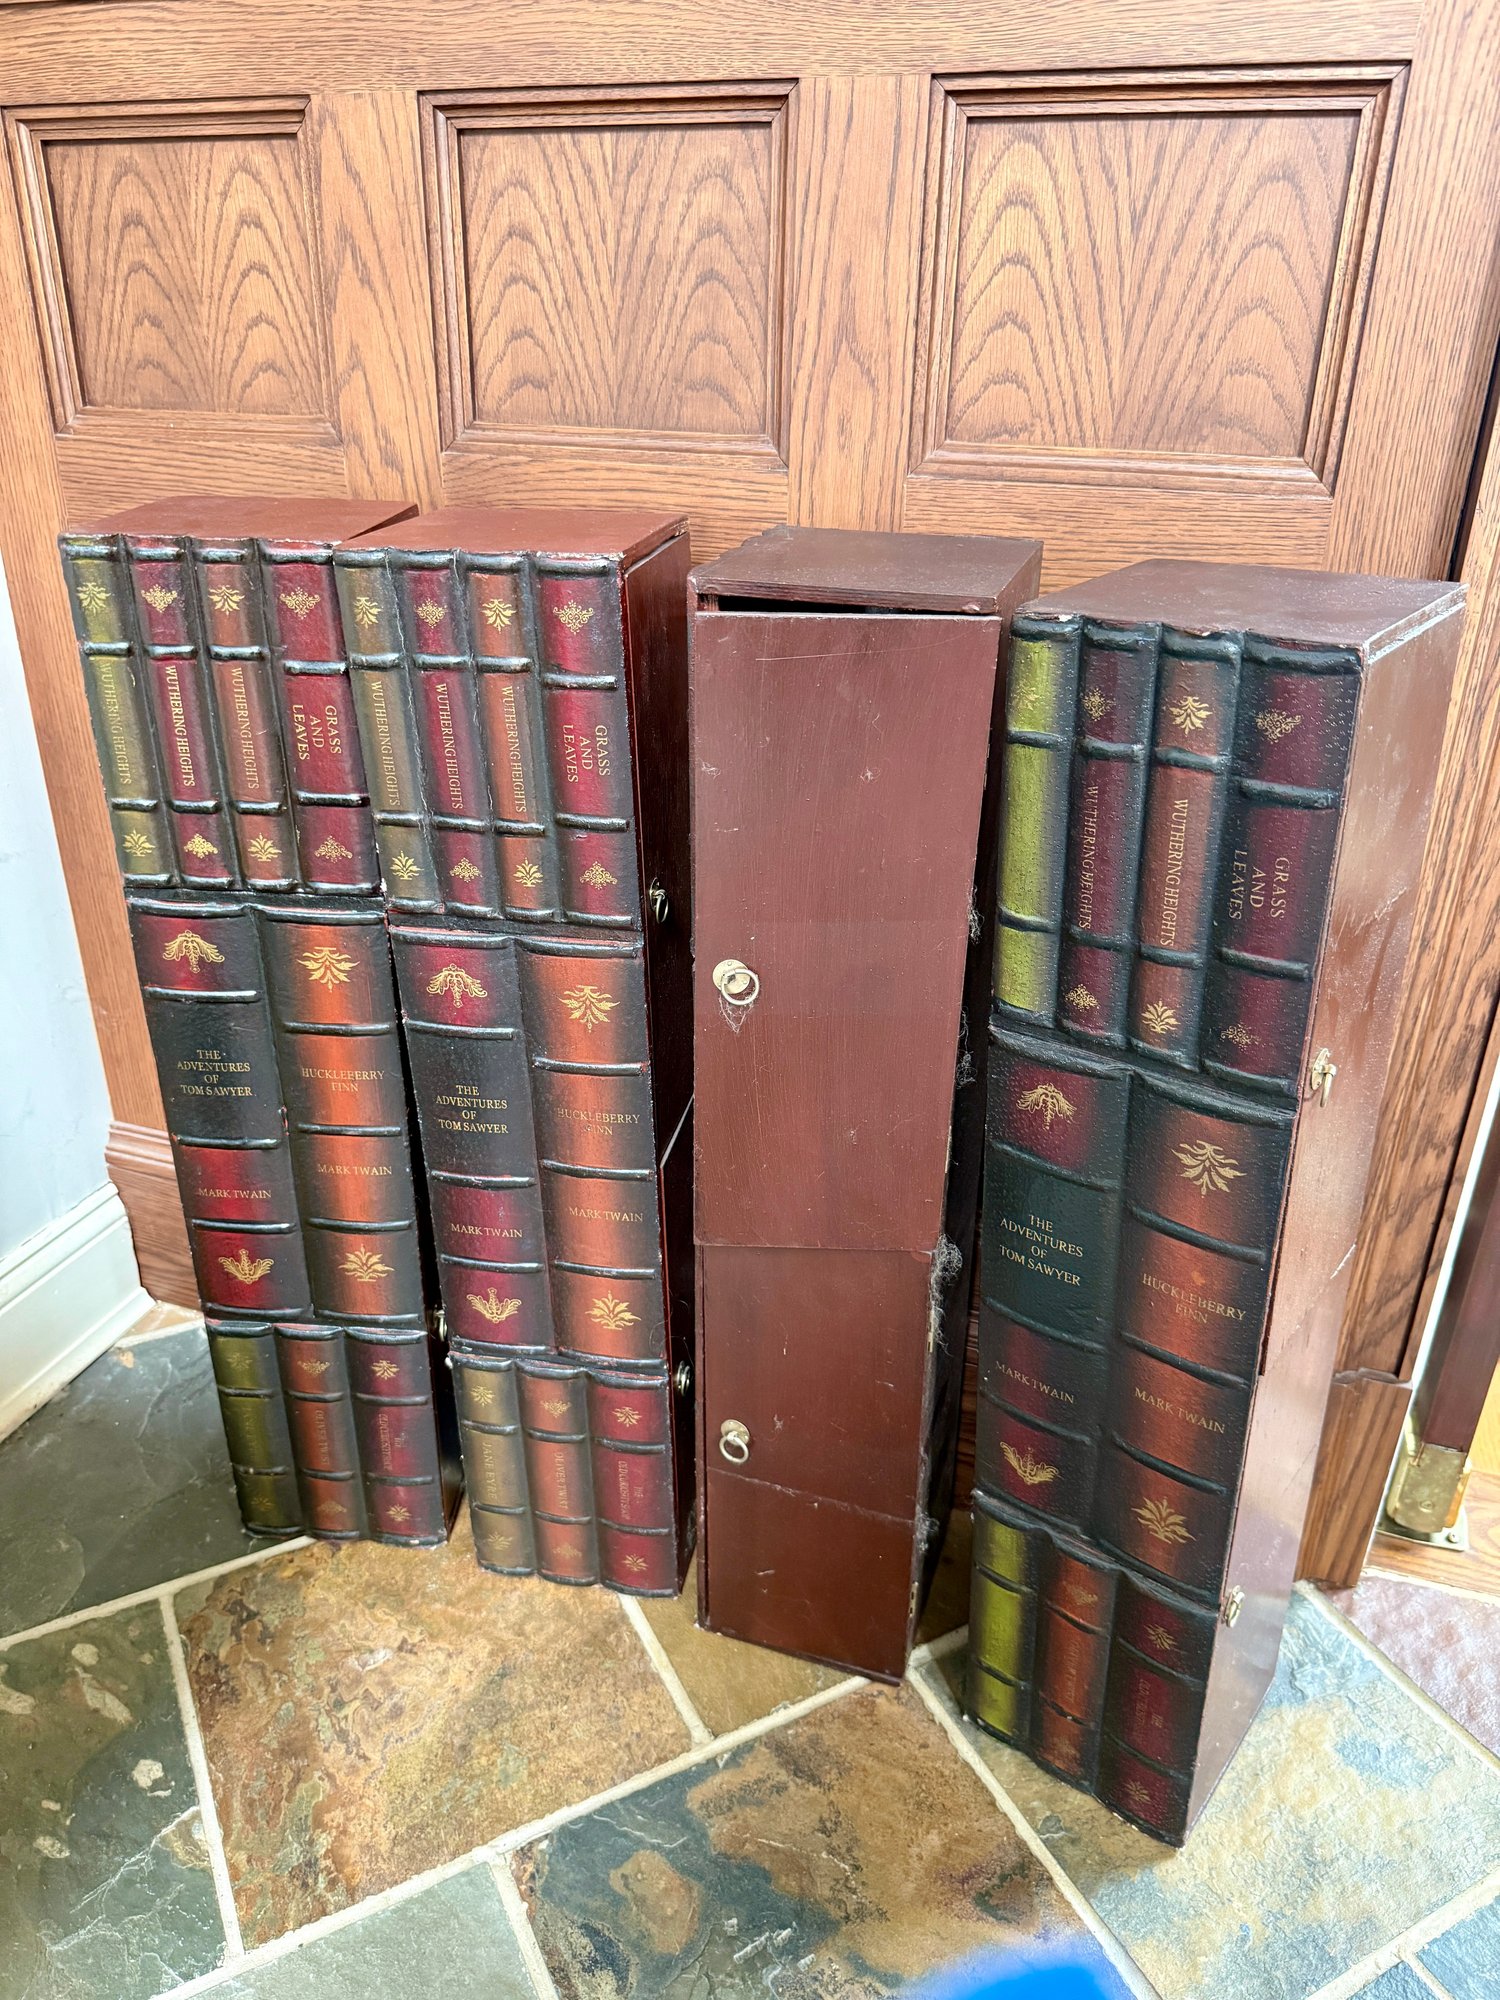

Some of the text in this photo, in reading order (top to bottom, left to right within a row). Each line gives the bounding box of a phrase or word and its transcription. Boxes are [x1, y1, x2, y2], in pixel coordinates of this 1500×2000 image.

[100, 663, 131, 784] WUTHERING HEIGHTS
[165, 665, 195, 787] WUTHERING HEIGHTS
[231, 667, 259, 789] WUTHERING HEIGHTS
[292, 704, 310, 760] LEAVES
[310, 714, 325, 748] AND
[325, 705, 342, 754] GRASS
[370, 681, 400, 806] WUTHERING HEIGHTS
[435, 683, 464, 809] WUTHERING HEIGHTS
[501, 686, 527, 813] WUTHERING HEIGHTS
[562, 724, 579, 783] LEAVES
[579, 735, 594, 770] AND
[595, 724, 611, 776] GRASS
[1078, 785, 1099, 930] WUTHERING HEIGHTS
[1160, 799, 1189, 947] WUTHERING HEIGHTS
[1228, 850, 1248, 920] LEAVES
[1250, 866, 1266, 908] AND
[1270, 857, 1290, 919] GRASS
[177, 1061, 251, 1072] ADVENTURES
[196, 1049, 221, 1060] THE
[180, 1084, 253, 1097] TOM SAWYER
[204, 1074, 220, 1084] OF
[302, 1067, 385, 1081] HUCKLEBERRY
[331, 1082, 359, 1092] FINN
[456, 1085, 480, 1096] THE
[436, 1095, 508, 1110] ADVENTURES
[461, 1109, 477, 1120] OF
[557, 1107, 640, 1124] HUCKLEBERRY
[438, 1119, 509, 1134] TOM SAWYER
[317, 1163, 392, 1176] MARK TWAIN
[199, 1187, 272, 1199] MARK TWAIN
[450, 1223, 523, 1238] MARK TWAIN
[569, 1206, 644, 1222] MARK TWAIN
[1029, 1214, 1053, 1233] THE
[1000, 1218, 1084, 1258] ADVENTURES
[1031, 1245, 1048, 1259] OF
[999, 1244, 1081, 1287] TOM SAWYER
[1142, 1273, 1246, 1321] HUCKLEBERRY
[1175, 1303, 1208, 1324] FINN
[995, 1360, 1075, 1404] MARK TWAIN
[1134, 1387, 1226, 1434] MARK TWAIN
[482, 1441, 495, 1469] JANE
